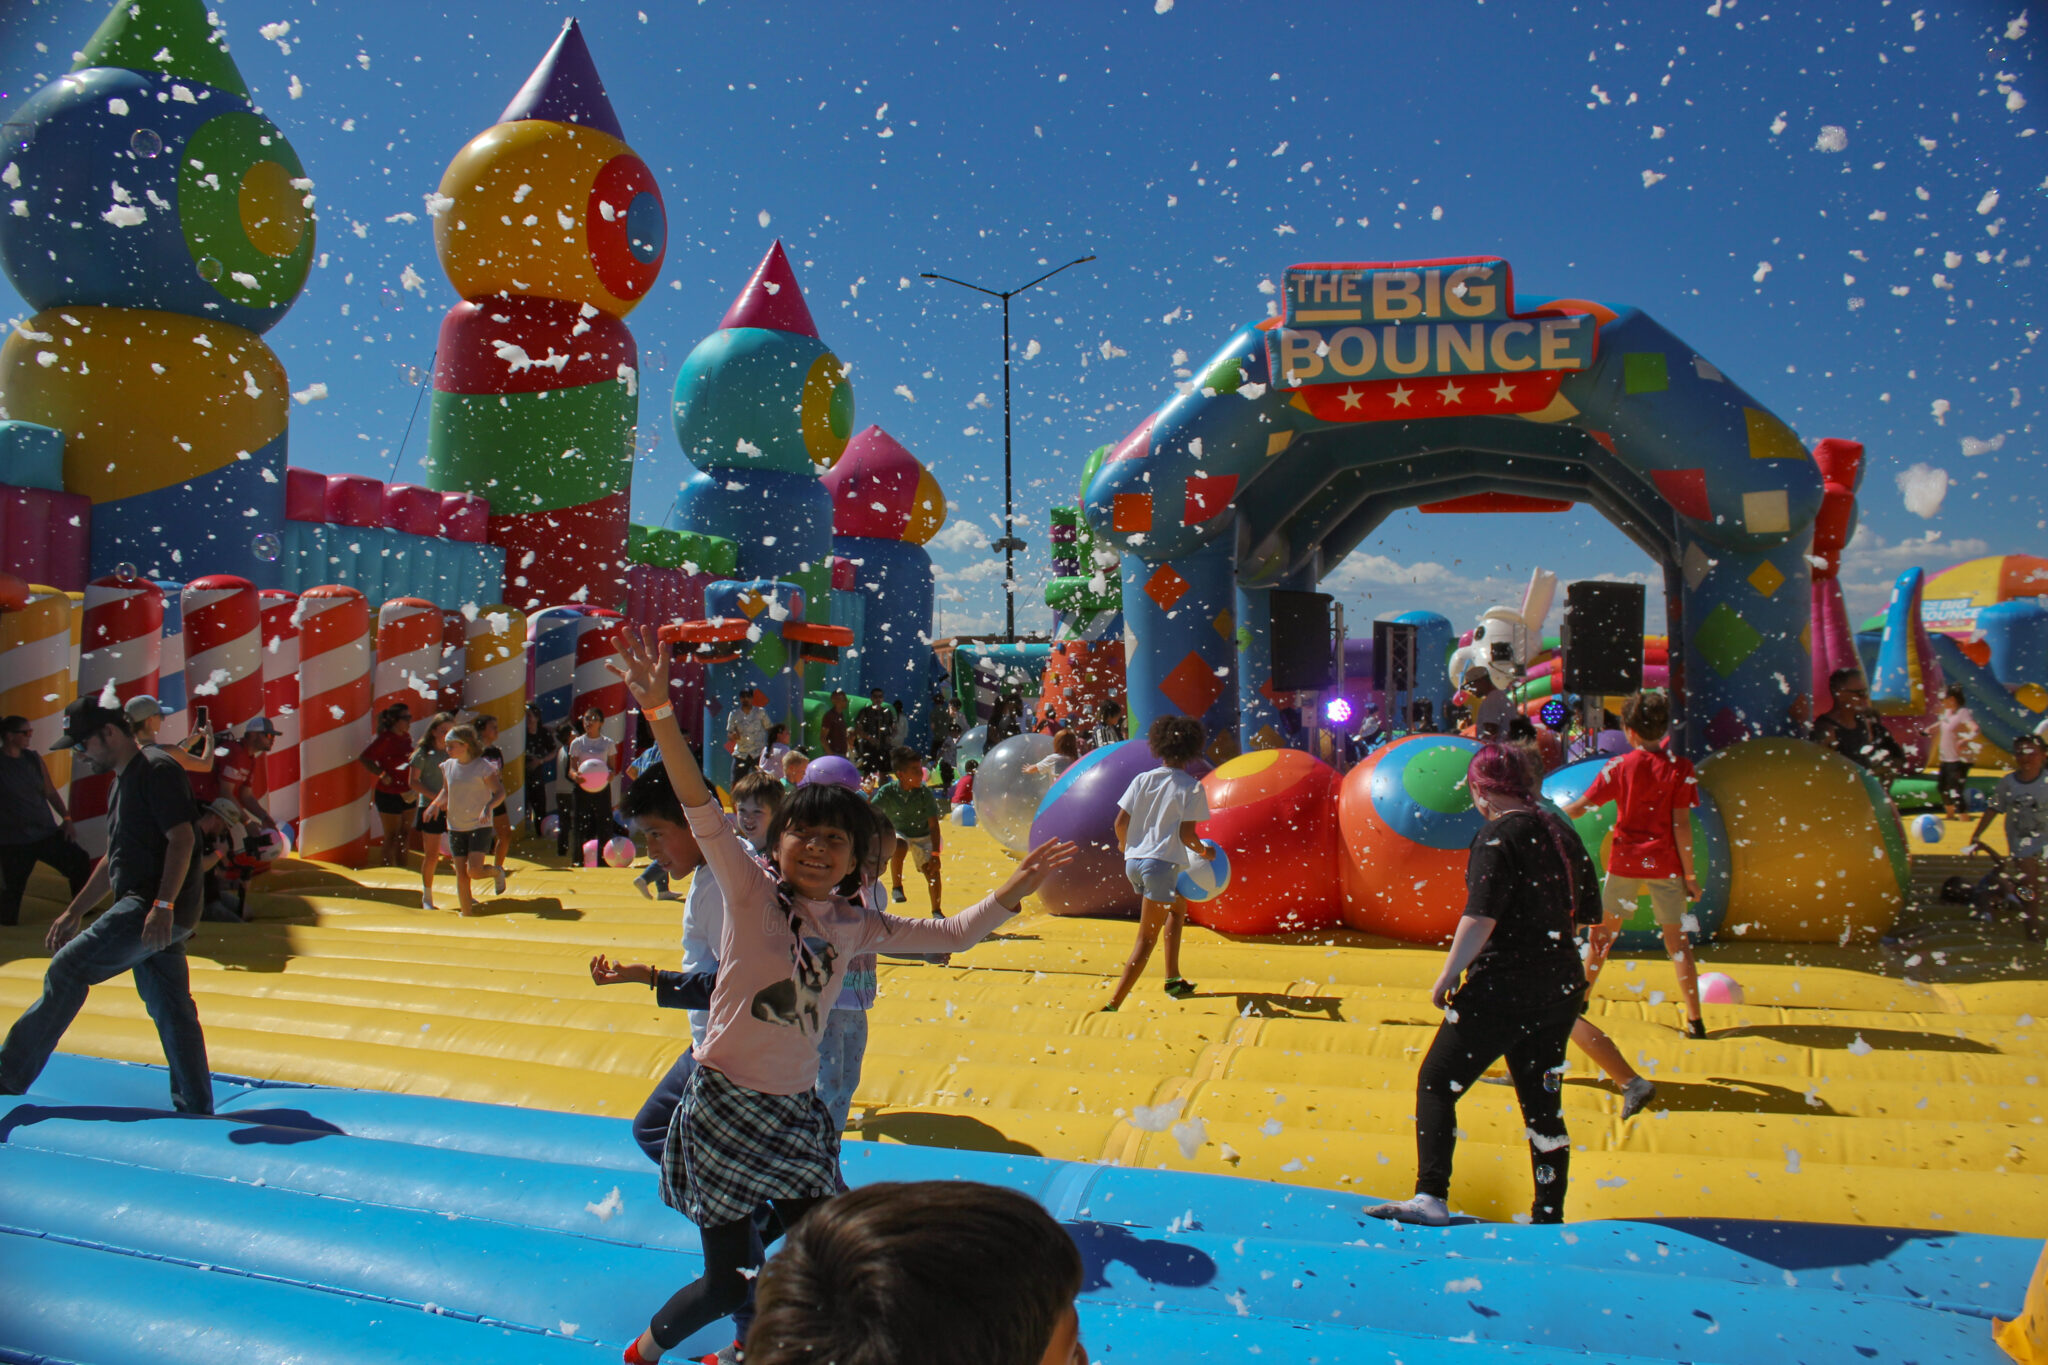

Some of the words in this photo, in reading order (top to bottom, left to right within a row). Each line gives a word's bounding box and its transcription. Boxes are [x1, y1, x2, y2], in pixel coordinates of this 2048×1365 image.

[1291, 273, 1363, 303] THE
[1372, 266, 1497, 320] BIG
[1281, 321, 1581, 379] BOUNCE
